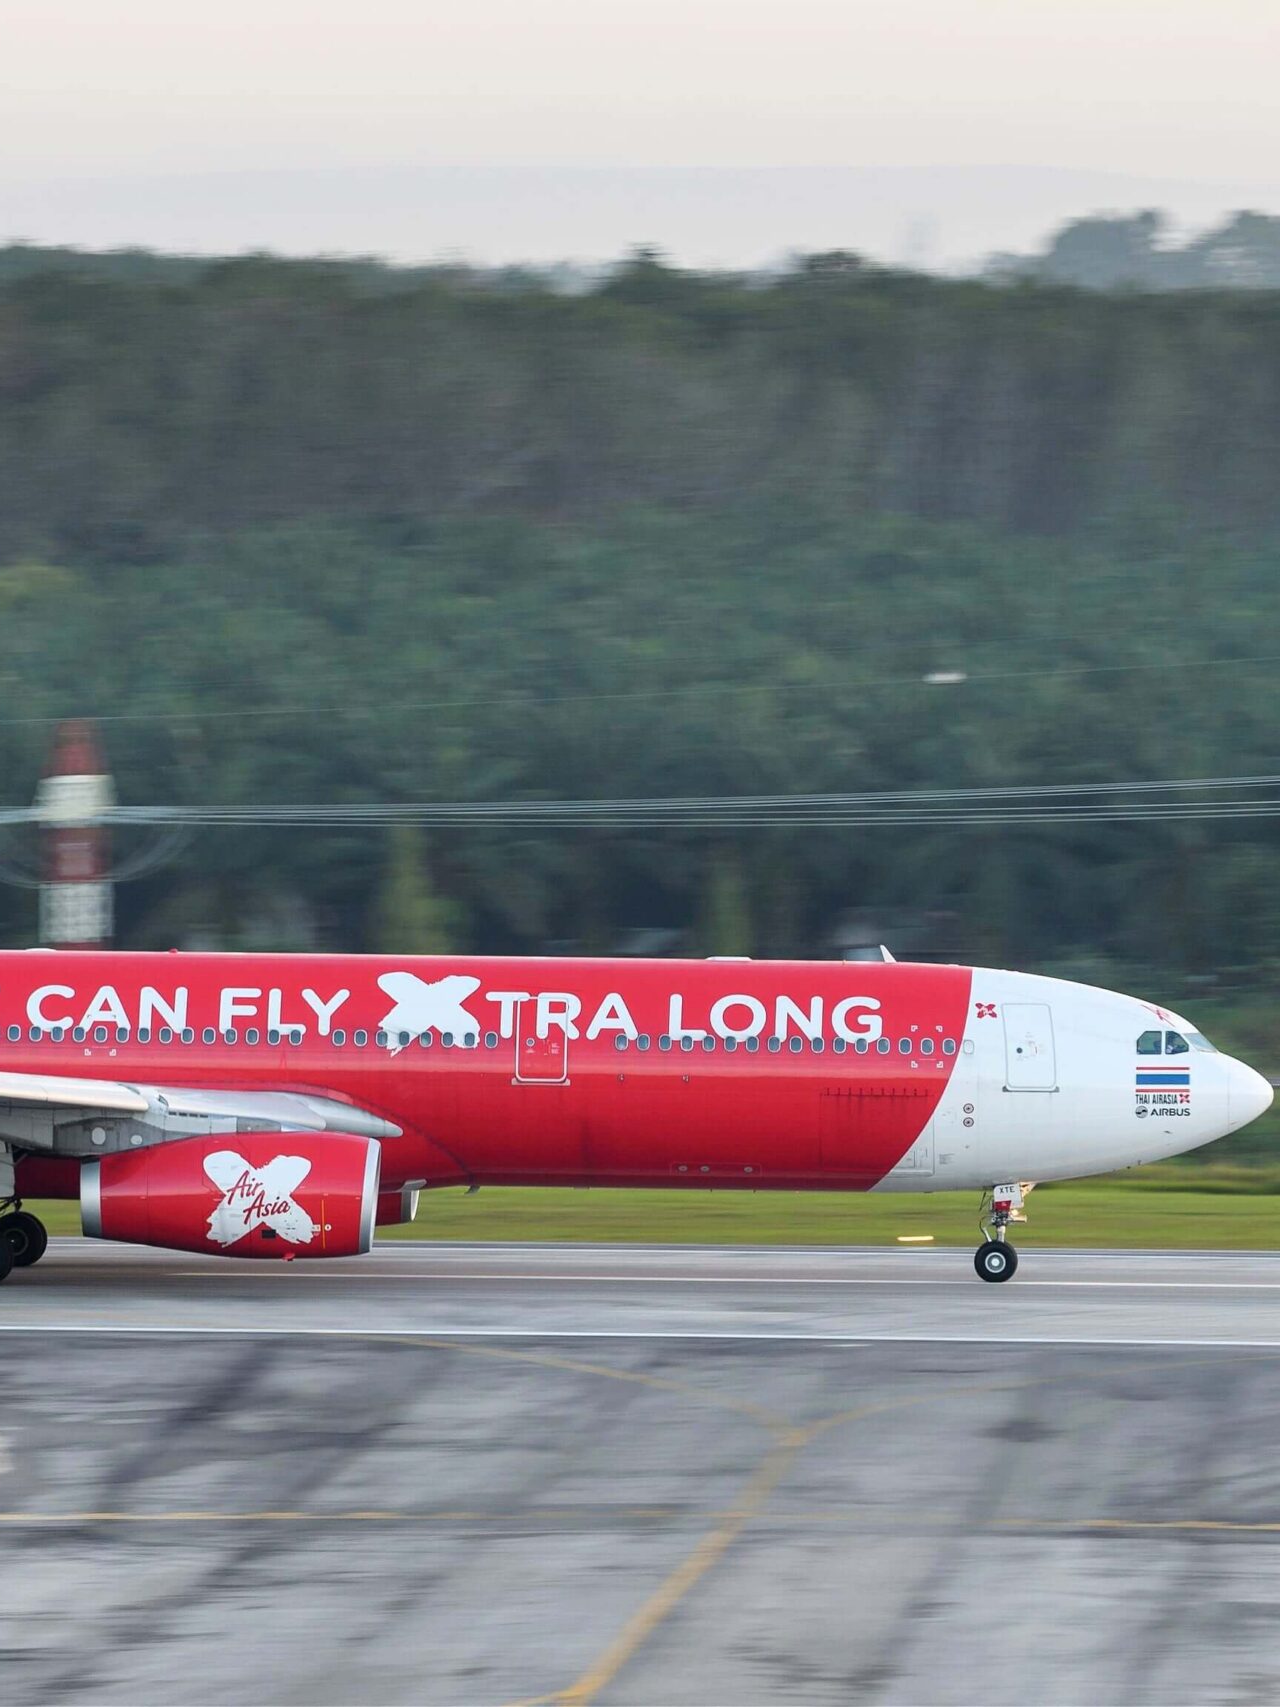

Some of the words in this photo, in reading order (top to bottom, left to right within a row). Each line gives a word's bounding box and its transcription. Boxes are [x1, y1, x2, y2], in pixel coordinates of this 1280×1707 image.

[26, 985, 189, 1034] CAN
[219, 988, 350, 1036] FLY
[668, 994, 883, 1044] LONG
[1135, 1093, 1150, 1105] THAI
[1152, 1093, 1178, 1105] AIRASIA
[1150, 1107, 1191, 1117] AIRBUS
[226, 1169, 263, 1206] Air
[999, 1186, 1015, 1194] XTE
[243, 1189, 291, 1225] Asia
